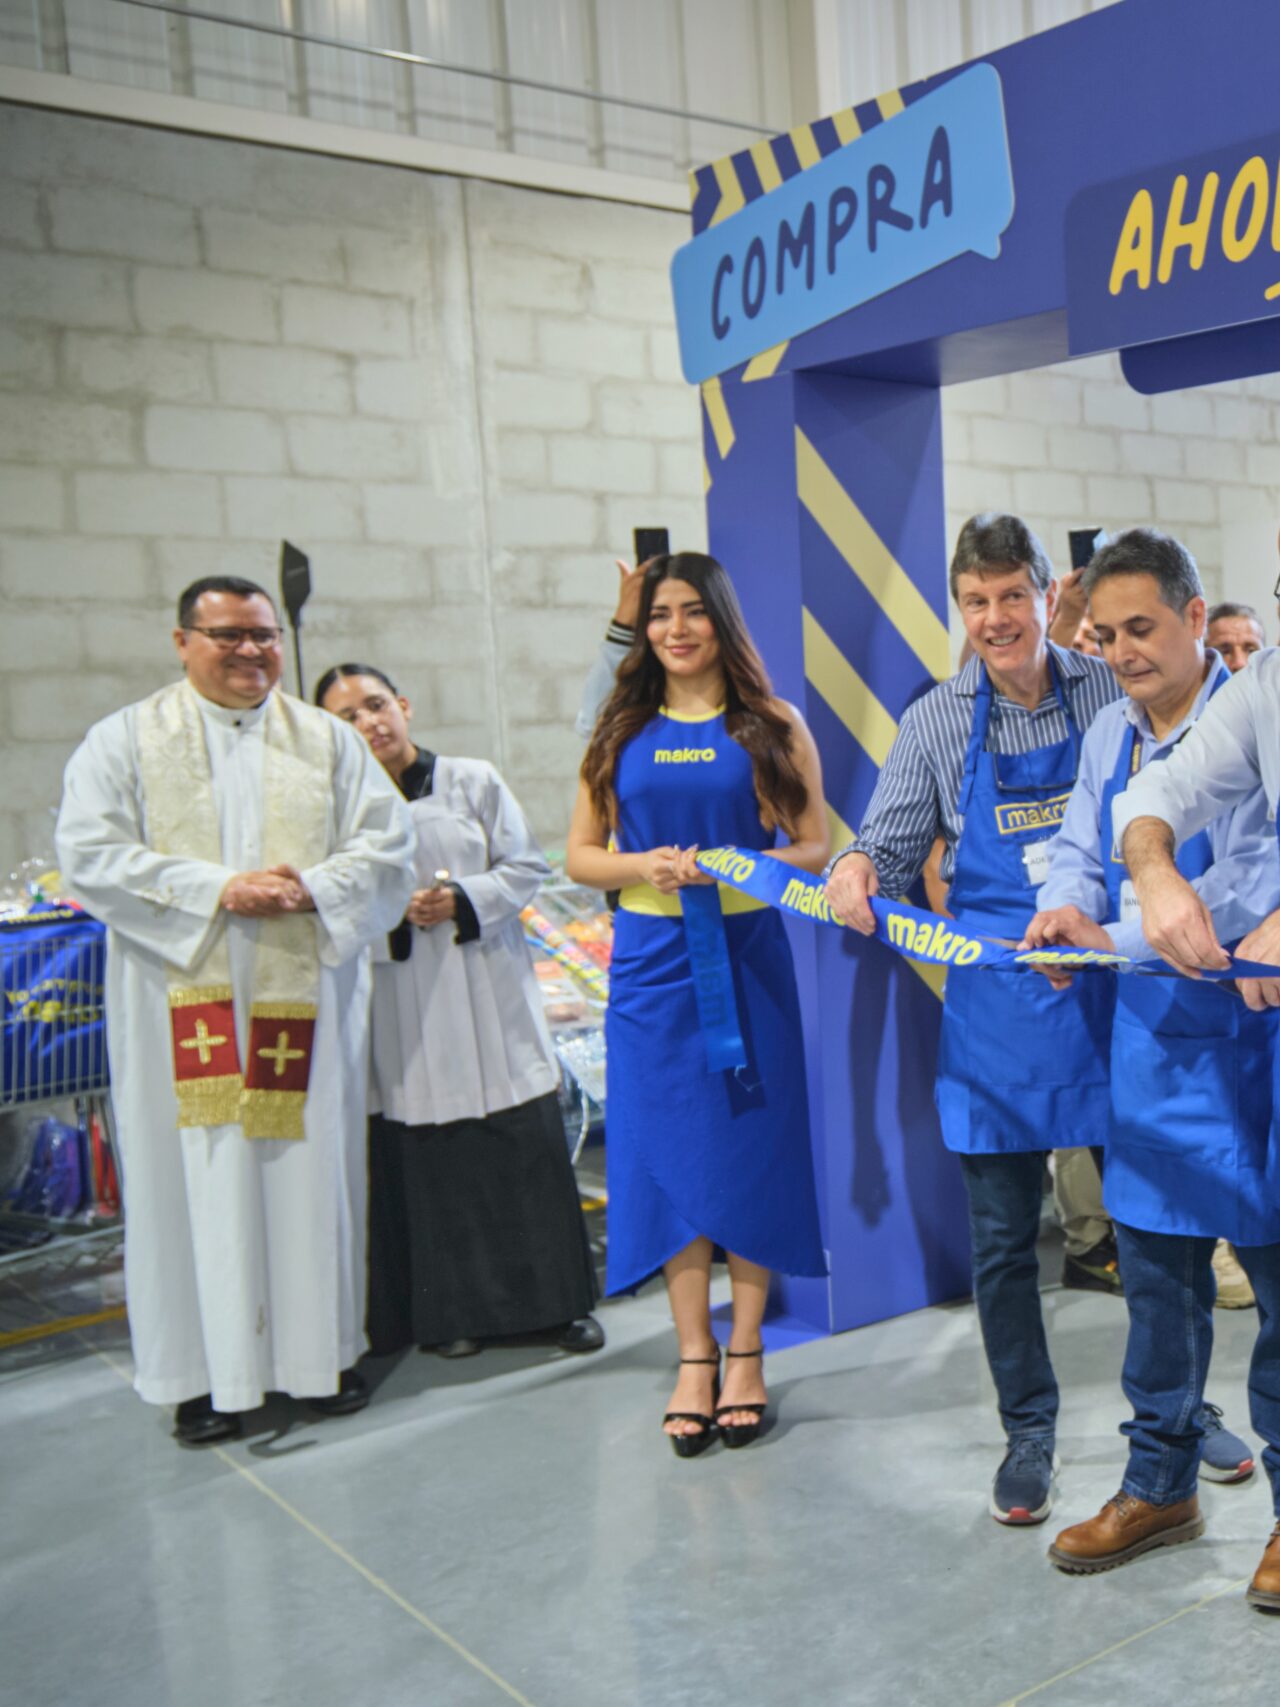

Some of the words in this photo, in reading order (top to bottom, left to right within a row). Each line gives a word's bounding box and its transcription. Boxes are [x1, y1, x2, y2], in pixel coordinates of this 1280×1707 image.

[711, 125, 954, 341] COMPRA
[654, 747, 717, 764] makro
[696, 847, 756, 883] akro
[887, 912, 983, 967] makro
